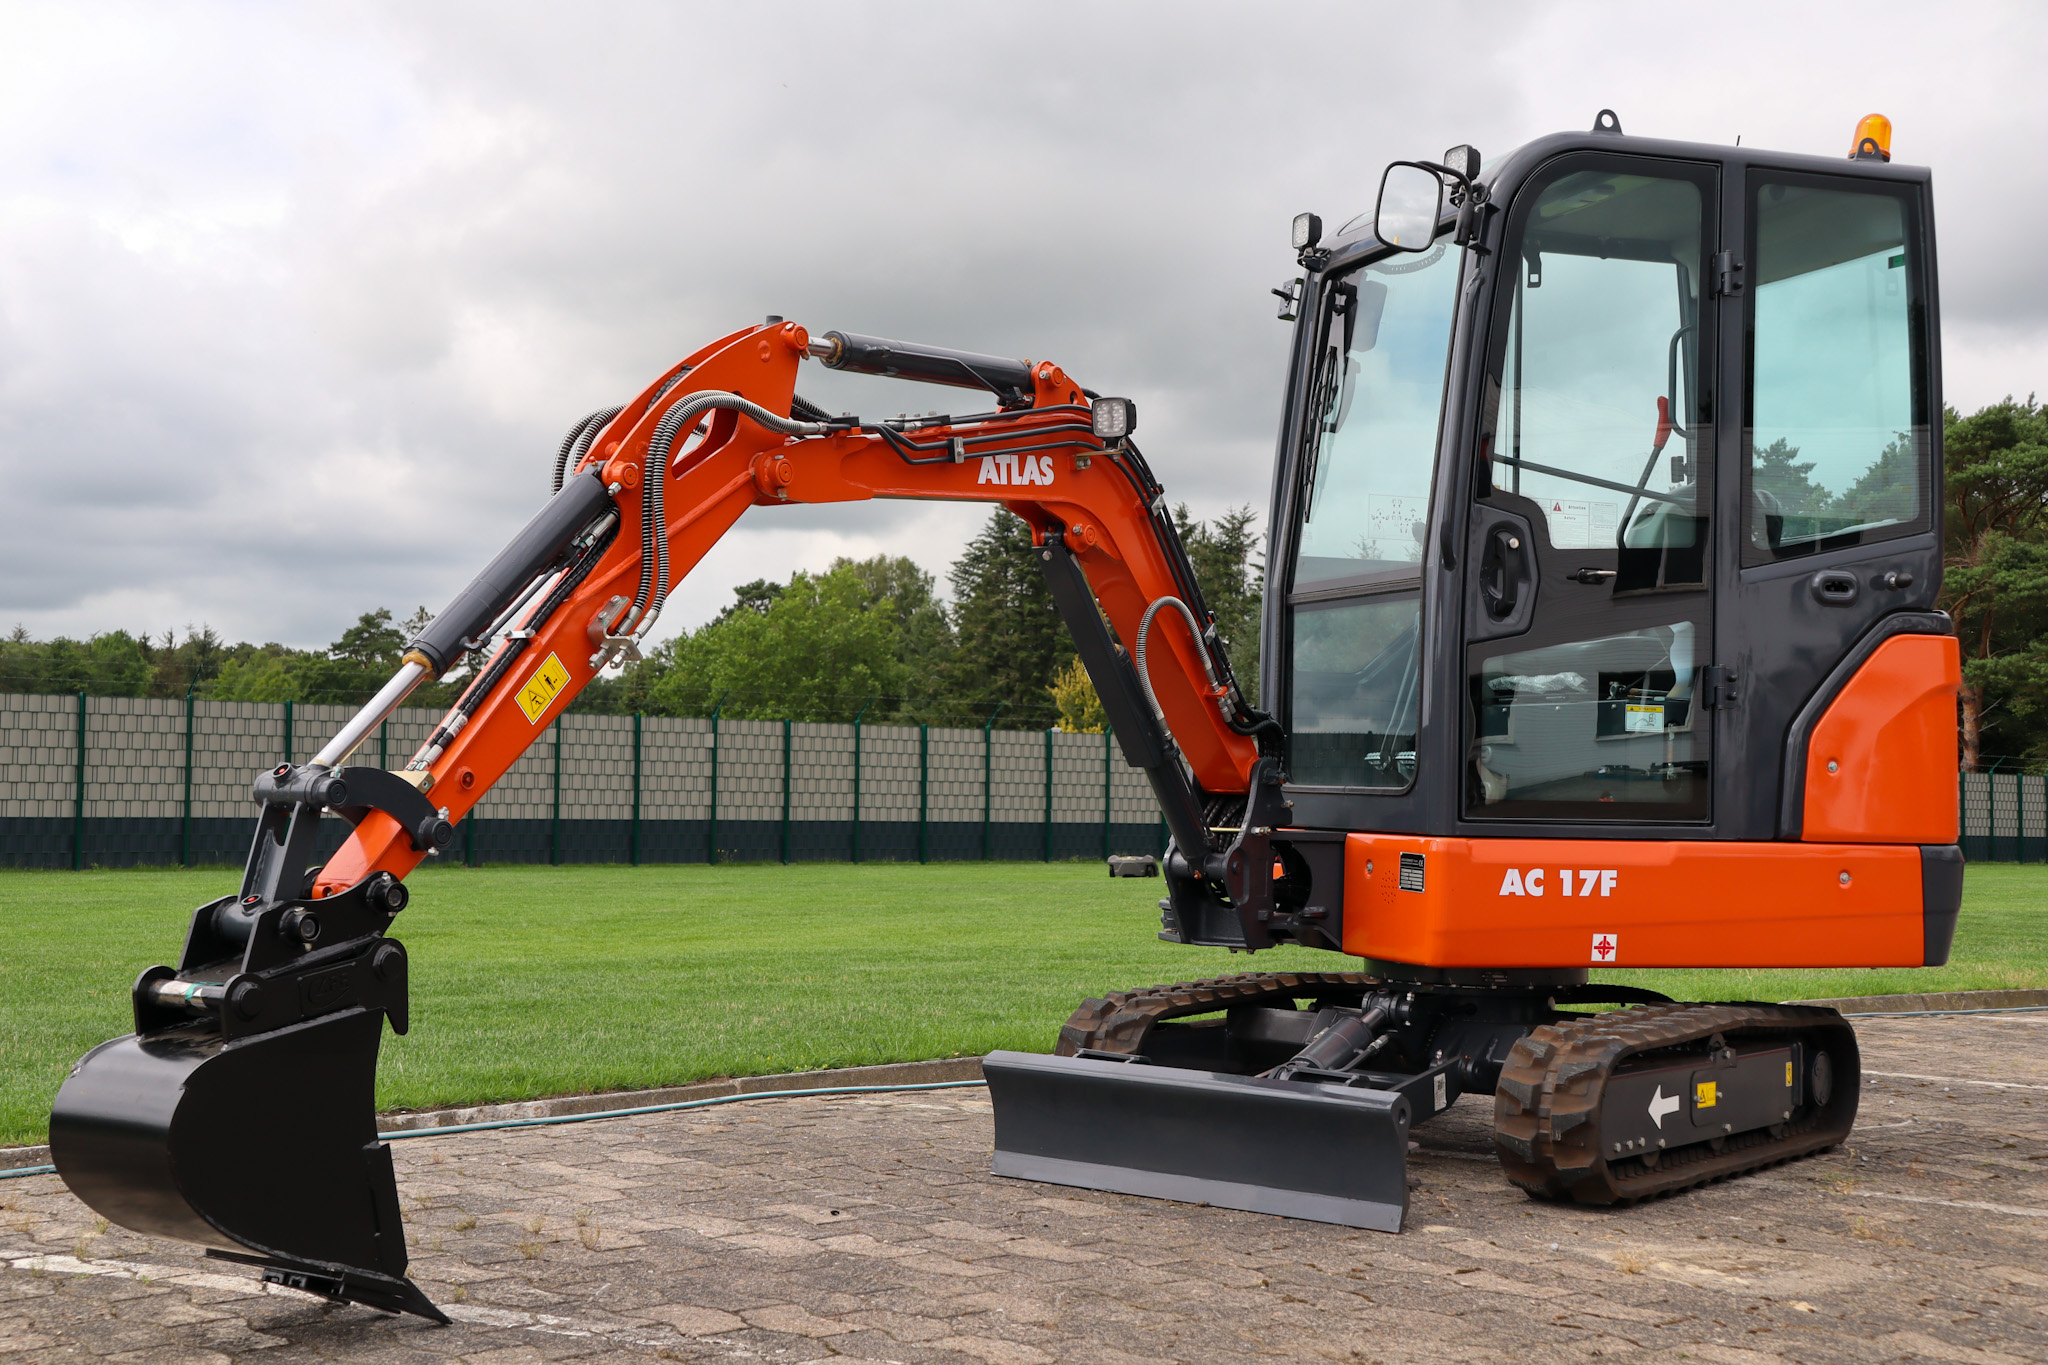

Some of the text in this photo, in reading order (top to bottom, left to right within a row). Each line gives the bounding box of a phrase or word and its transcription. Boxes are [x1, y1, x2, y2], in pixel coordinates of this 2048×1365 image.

[977, 455, 1055, 486] ATLAS
[1498, 868, 1618, 897] AC 17F
